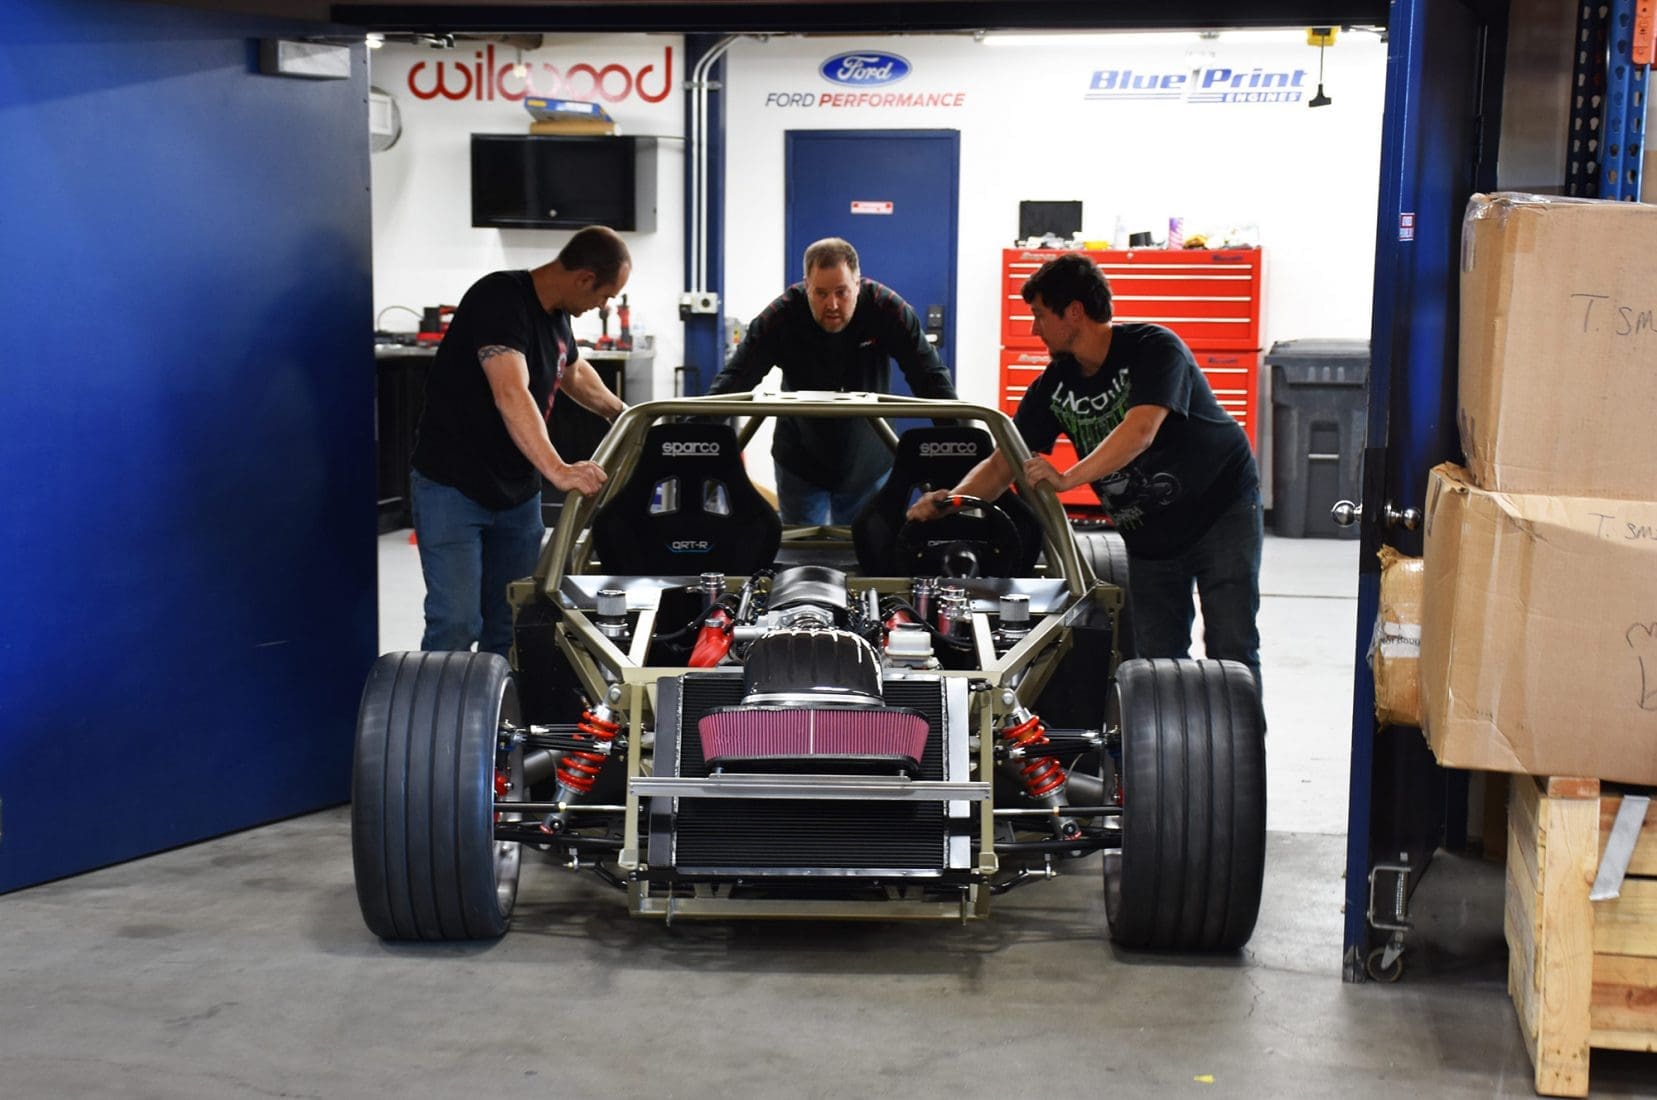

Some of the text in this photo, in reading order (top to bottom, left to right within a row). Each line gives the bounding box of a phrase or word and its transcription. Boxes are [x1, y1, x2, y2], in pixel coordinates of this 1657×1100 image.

[837, 56, 893, 80] Ford
[765, 93, 966, 108] FORD PERFORMANCE
[662, 441, 720, 457] sparco
[920, 441, 977, 457] sparco
[672, 540, 709, 550] QRT-R
